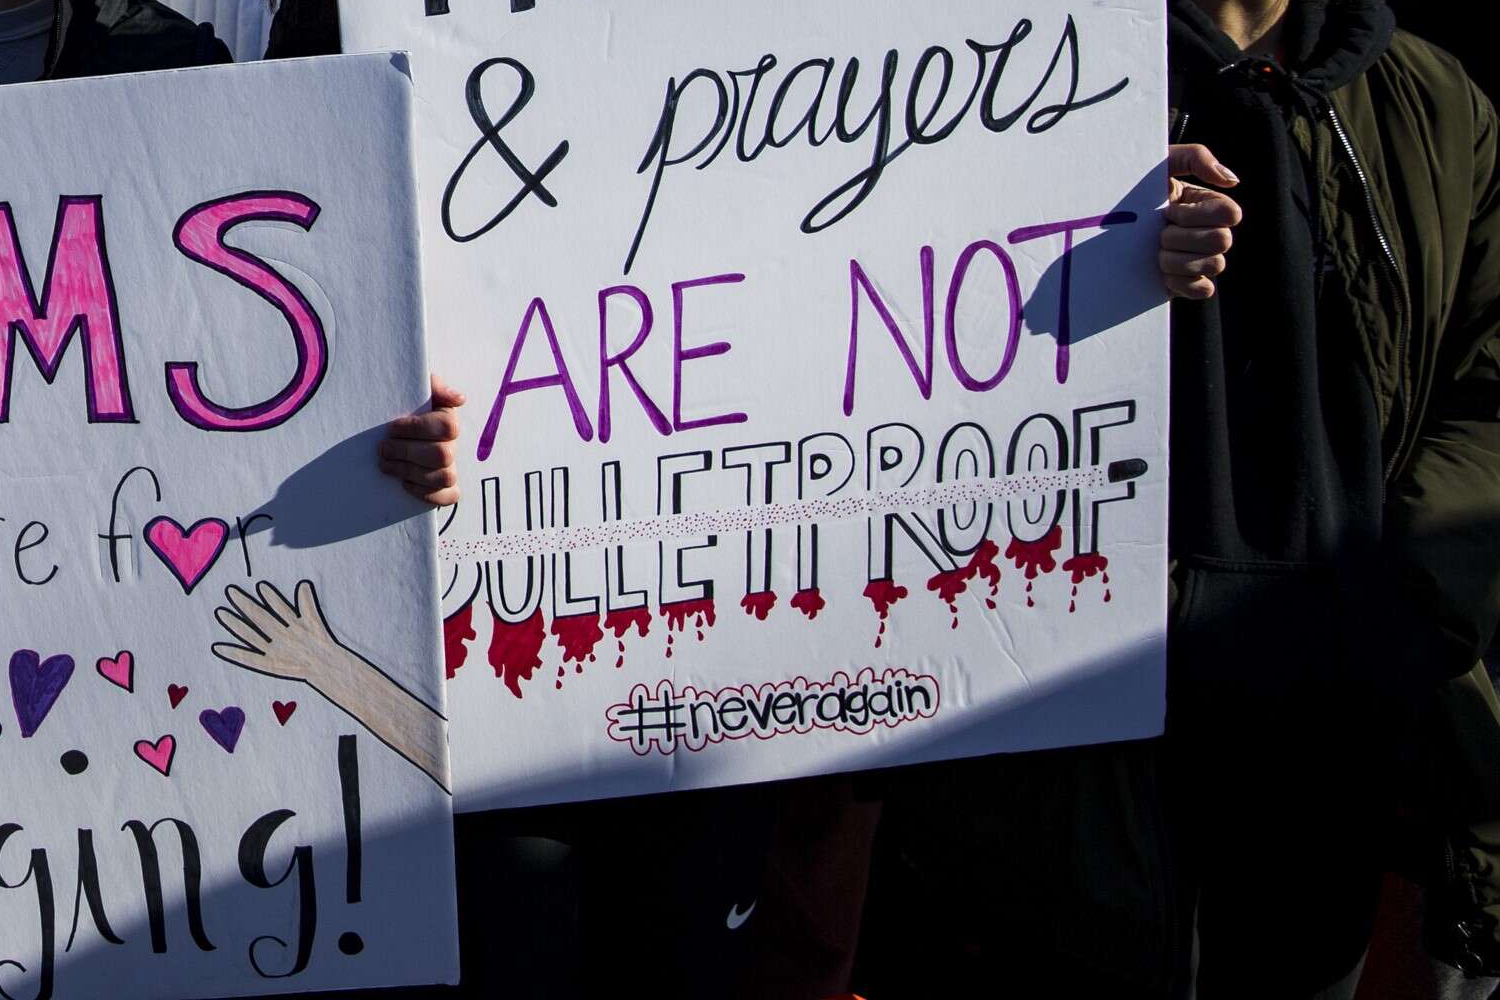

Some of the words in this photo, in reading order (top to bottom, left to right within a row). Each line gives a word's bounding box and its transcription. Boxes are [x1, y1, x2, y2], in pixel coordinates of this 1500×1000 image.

[441, 56, 570, 242] &
[623, 13, 1130, 275] prayers
[476, 272, 749, 462] ARE
[842, 211, 1138, 417] NOT
[617, 680, 934, 754] #neveragain
